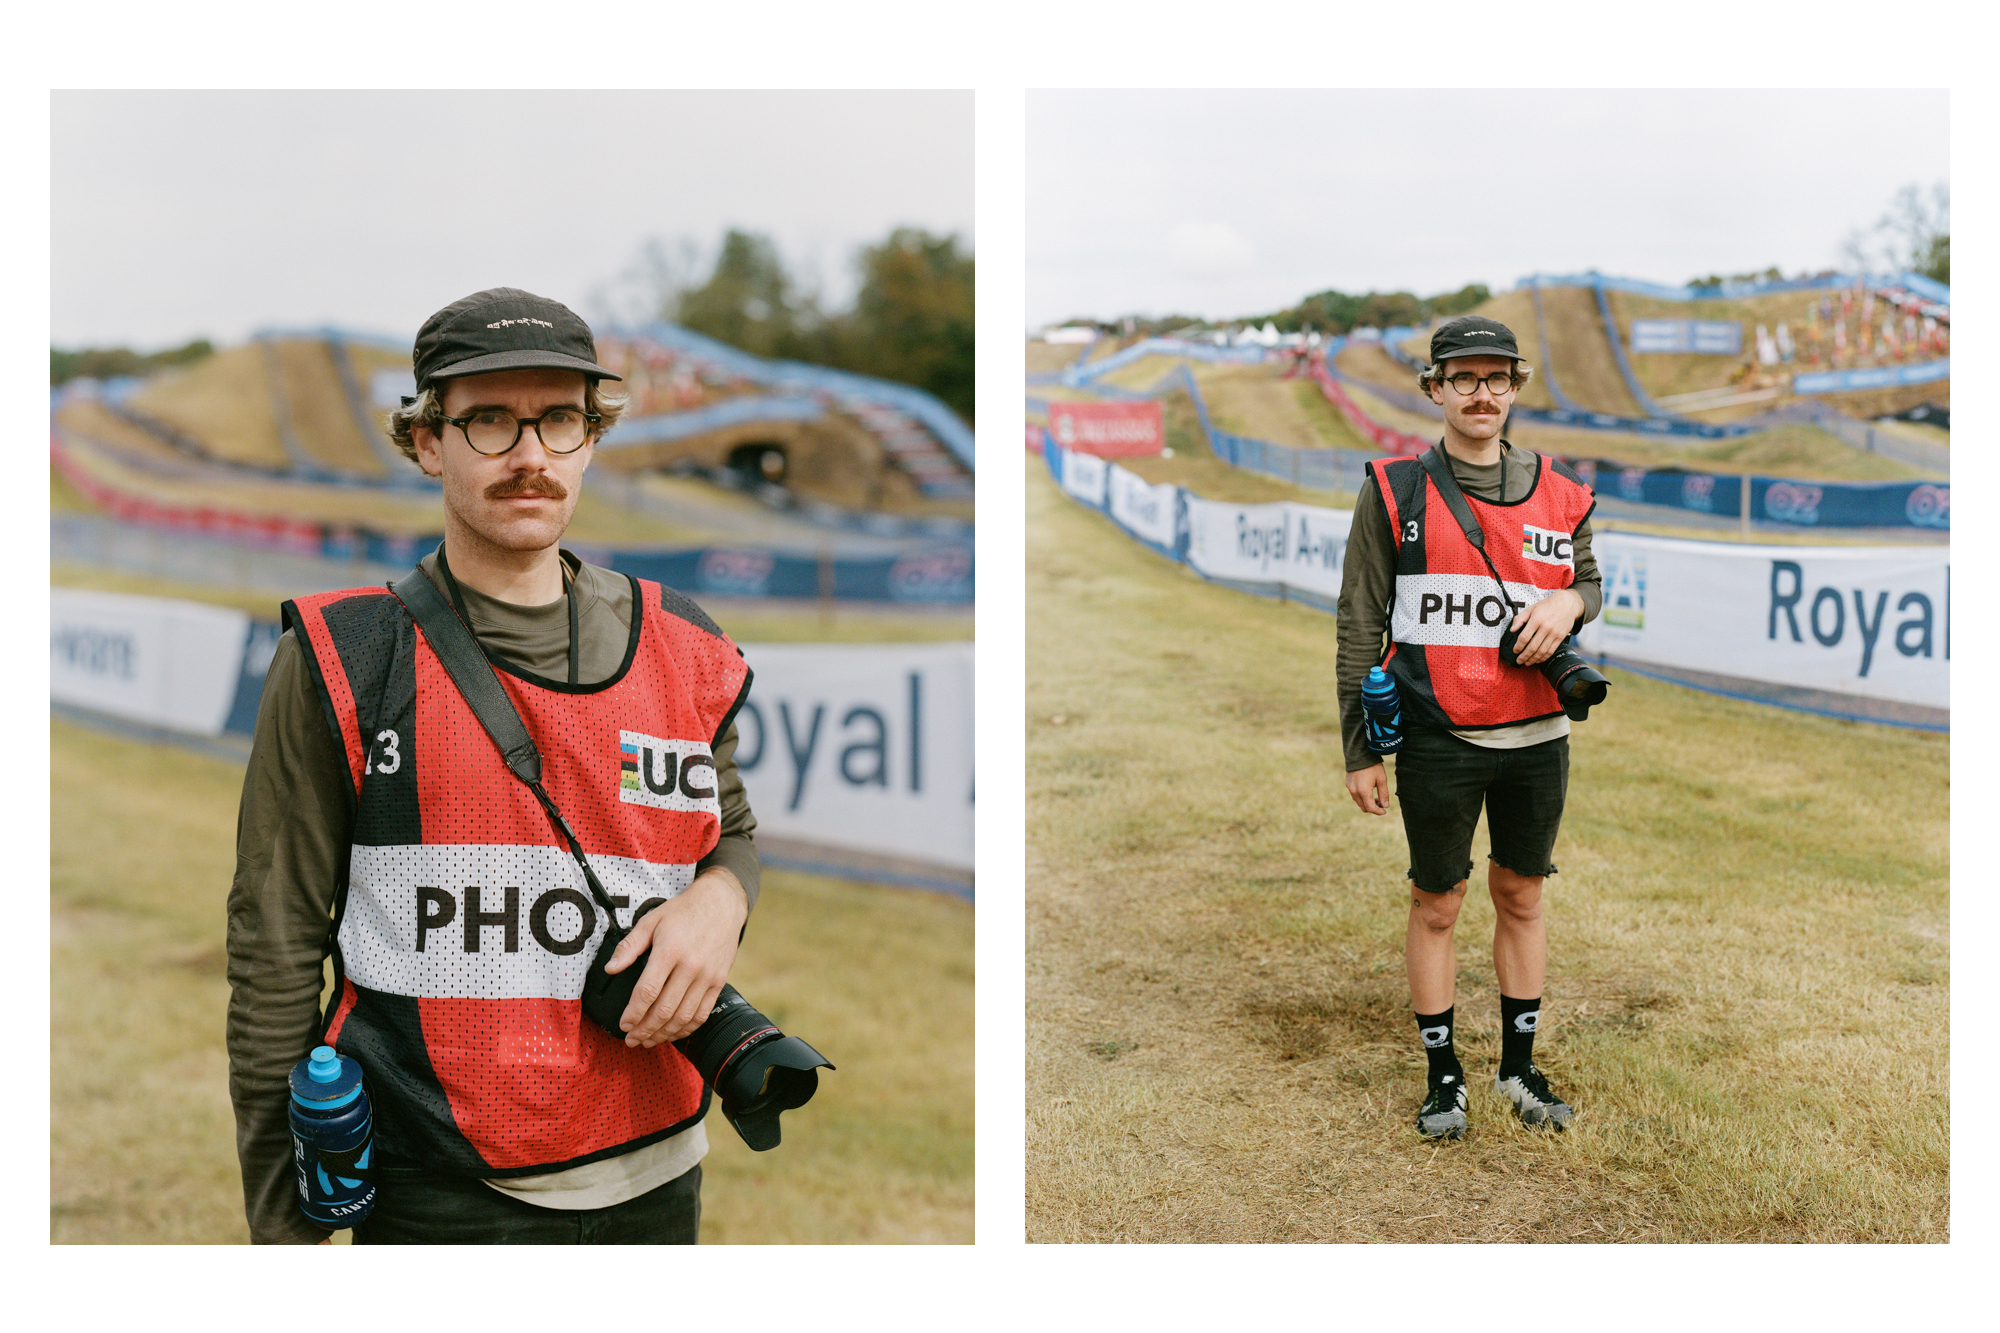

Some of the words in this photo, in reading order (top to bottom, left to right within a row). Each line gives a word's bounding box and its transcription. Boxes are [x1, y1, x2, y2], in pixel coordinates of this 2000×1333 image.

[1235, 510, 1291, 574] Royal
[1768, 558, 1950, 678] Royal
[642, 746, 716, 799] UC
[293, 1134, 309, 1202] ELITE
[330, 1186, 377, 1217] CANYON
